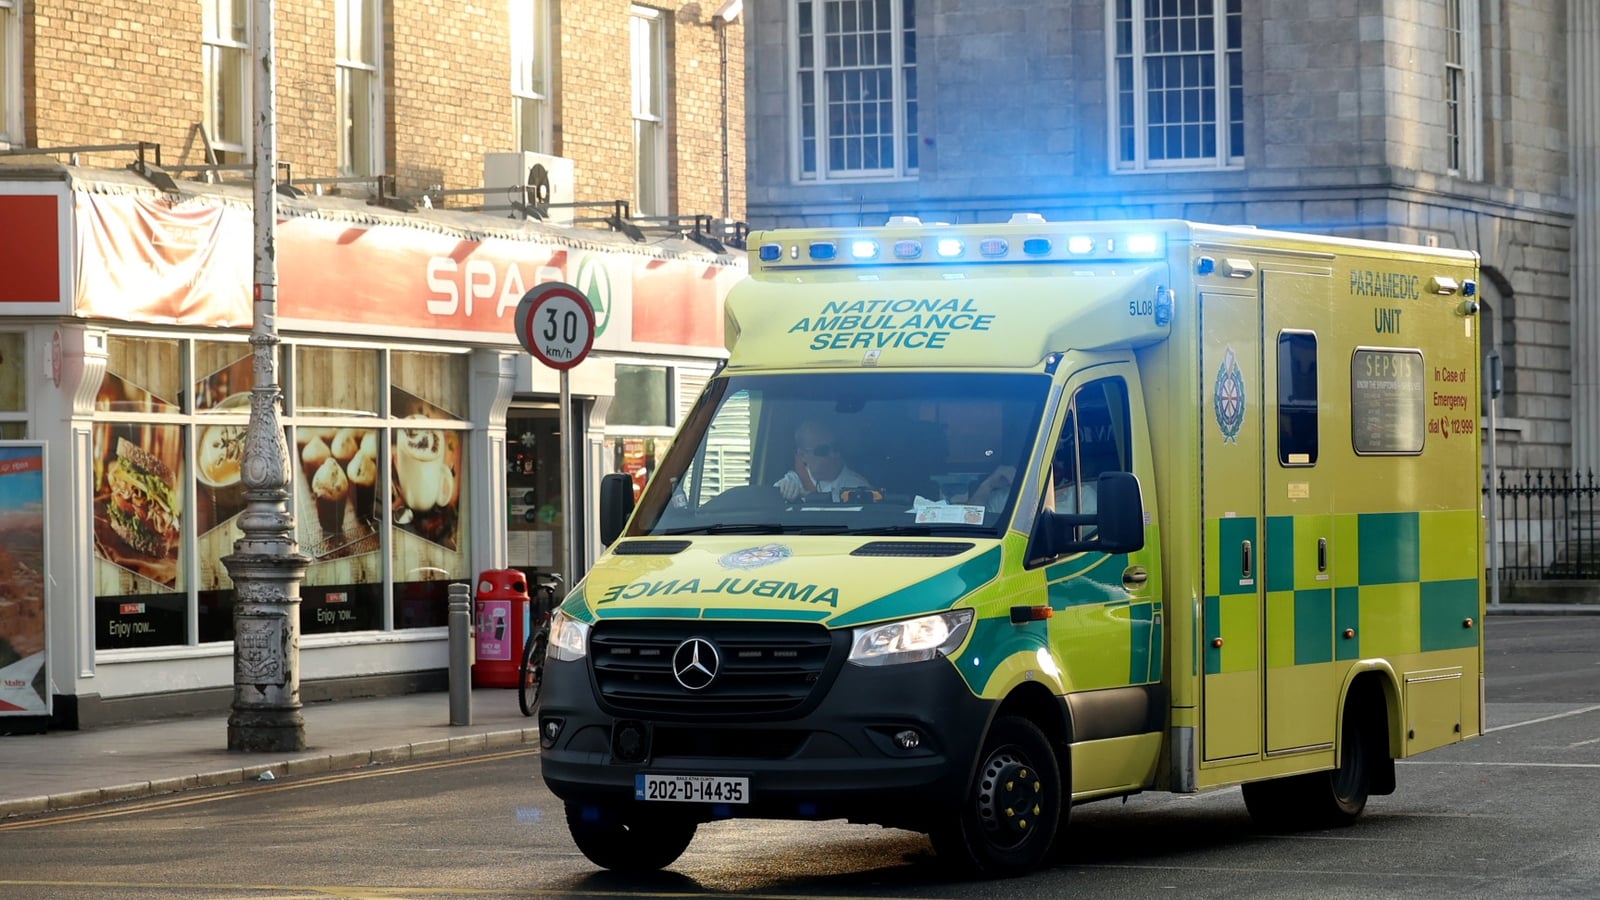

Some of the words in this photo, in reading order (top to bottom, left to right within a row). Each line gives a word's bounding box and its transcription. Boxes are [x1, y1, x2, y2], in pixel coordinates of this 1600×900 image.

[1350, 270, 1419, 300] PARAMEDIC
[821, 299, 978, 314] NATIONAL
[1129, 300, 1153, 316] 5L08
[543, 307, 577, 344] 30
[787, 314, 996, 333] AMBULANCE
[1374, 308, 1402, 334] UNIT
[809, 331, 951, 350] SERVICE
[545, 345, 573, 359] km/h
[1366, 355, 1412, 378] SEPSIS
[1434, 367, 1440, 382] In
[1442, 367, 1458, 382] Case
[1459, 368, 1466, 382] of
[1433, 391, 1467, 411] Emergency
[1428, 418, 1440, 433] dial
[317, 608, 336, 624] Enjoy
[109, 620, 131, 638] Enjoy
[648, 780, 743, 801] 202-D-14435
